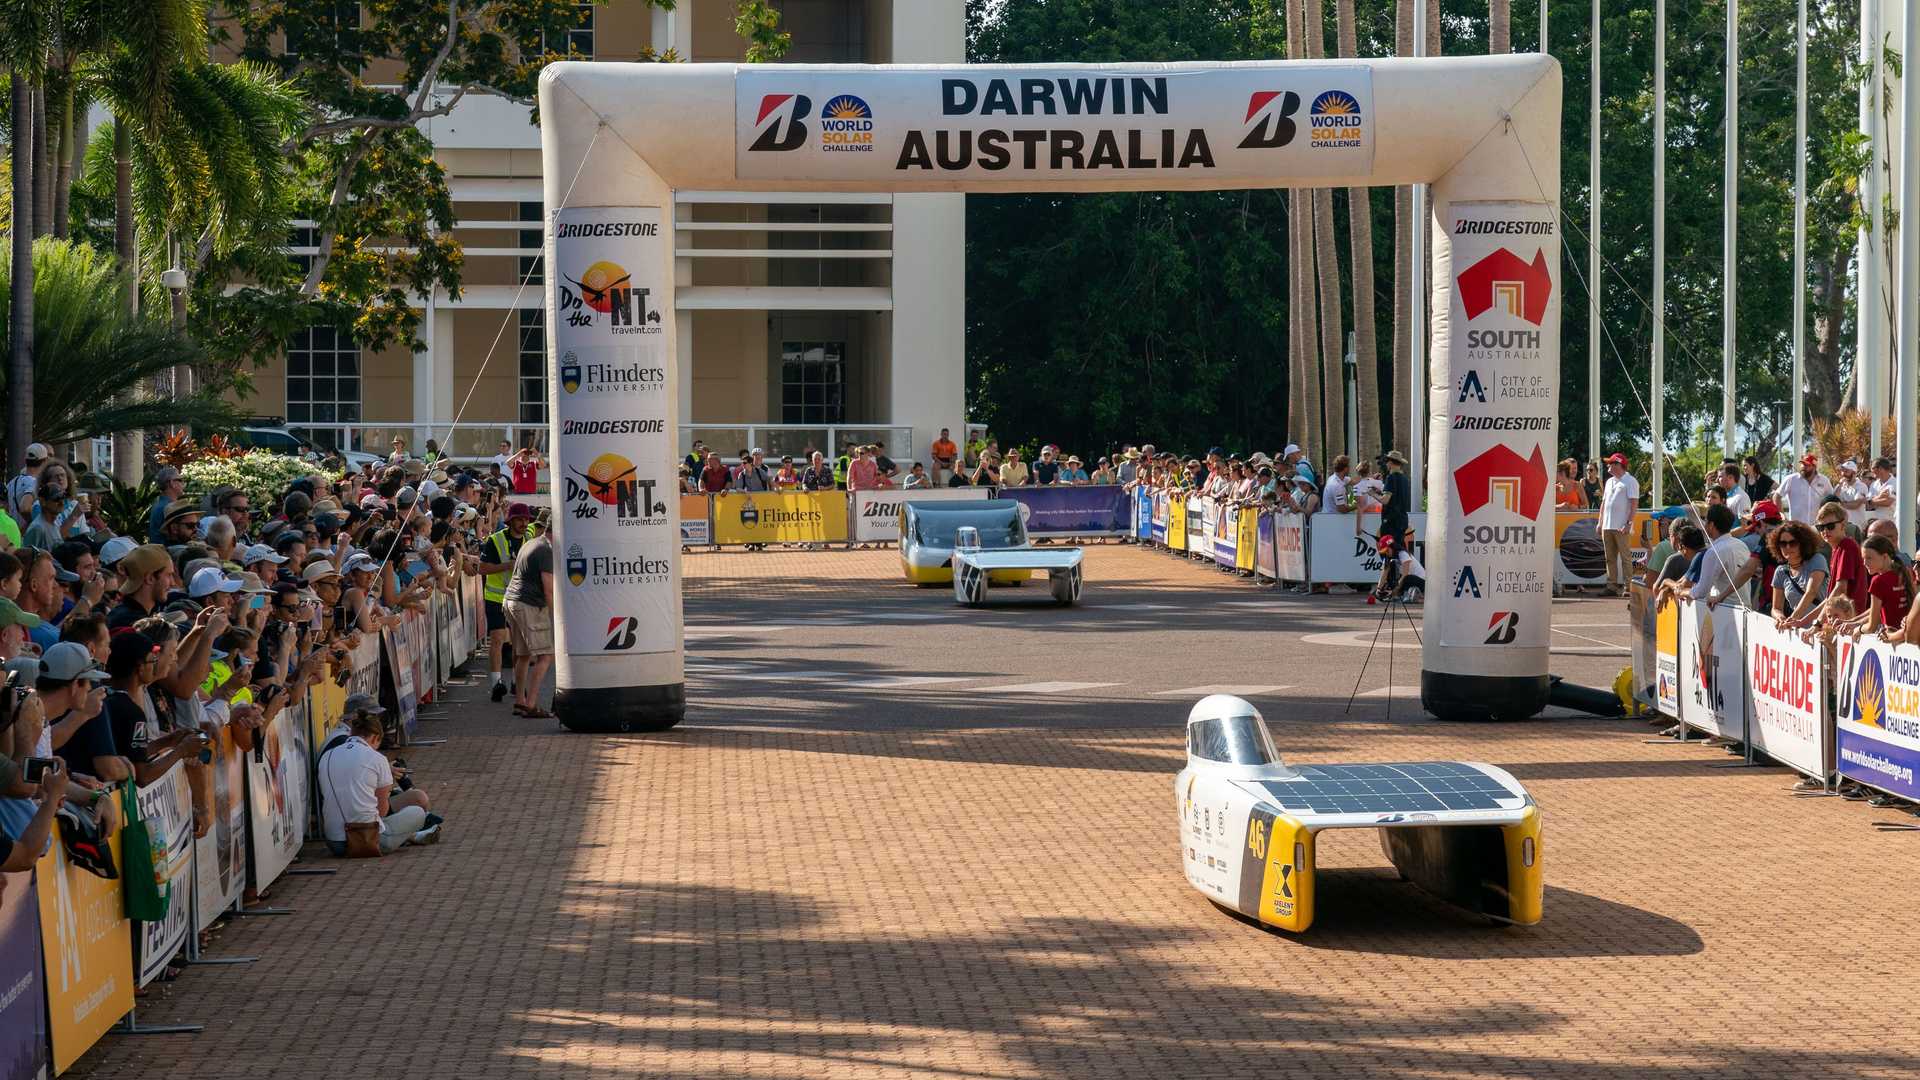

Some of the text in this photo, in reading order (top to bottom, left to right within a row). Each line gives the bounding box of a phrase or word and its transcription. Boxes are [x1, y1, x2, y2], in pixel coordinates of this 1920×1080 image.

[941, 77, 1168, 115] DARWIN
[822, 120, 873, 132] WORLD
[1311, 116, 1361, 127] WORLD
[822, 132, 873, 144] SOLAR
[1311, 128, 1361, 139] SOLAR
[822, 144, 873, 152] CHALLENGE
[896, 128, 1216, 170] AUSTRALIA
[1311, 140, 1361, 148] CHALLENGE
[558, 222, 658, 238] BRIDGESTONE
[1455, 219, 1553, 235] BRIDGESTONE
[559, 286, 583, 311] Do
[611, 288, 650, 325] NT
[565, 310, 593, 327] the
[611, 326, 662, 335] travelnt.com
[1467, 330, 1540, 349] SOUTH
[1467, 351, 1540, 360] AUSTRALIA
[587, 363, 664, 384] Flinders
[1501, 375, 1542, 386] CITY OF
[587, 383, 664, 393] UNIVERSITY
[1501, 387, 1550, 398] ADELAIDE
[563, 419, 664, 435] BRIDGESTONE
[1452, 415, 1552, 430] BRIDGESTONE
[565, 477, 589, 502] Do
[617, 480, 656, 518] NT
[572, 502, 599, 519] the
[763, 507, 822, 523] Flinders
[617, 518, 667, 527] travelnt.com
[870, 520, 888, 528] Your
[1463, 525, 1536, 545] SOUTH
[1354, 537, 1378, 558] Do
[1463, 546, 1536, 555] AUSTRALIA
[592, 555, 669, 577] Flinders
[1360, 557, 1383, 571] the
[592, 575, 669, 585] UNIVERSITY
[1496, 571, 1537, 582] CITY OF
[1495, 582, 1545, 593] ADELAIDE
[1753, 643, 1814, 714] ADELAIDE
[1889, 655, 1919, 687] WORLD
[1887, 685, 1919, 717] SOLAR
[1753, 697, 1815, 745] SOUTH AUSTRALIA
[1887, 716, 1919, 739] CHALLENGE
[1841, 747, 1913, 785] www.worldsolarchallenge.org
[1248, 818, 1265, 859] 46
